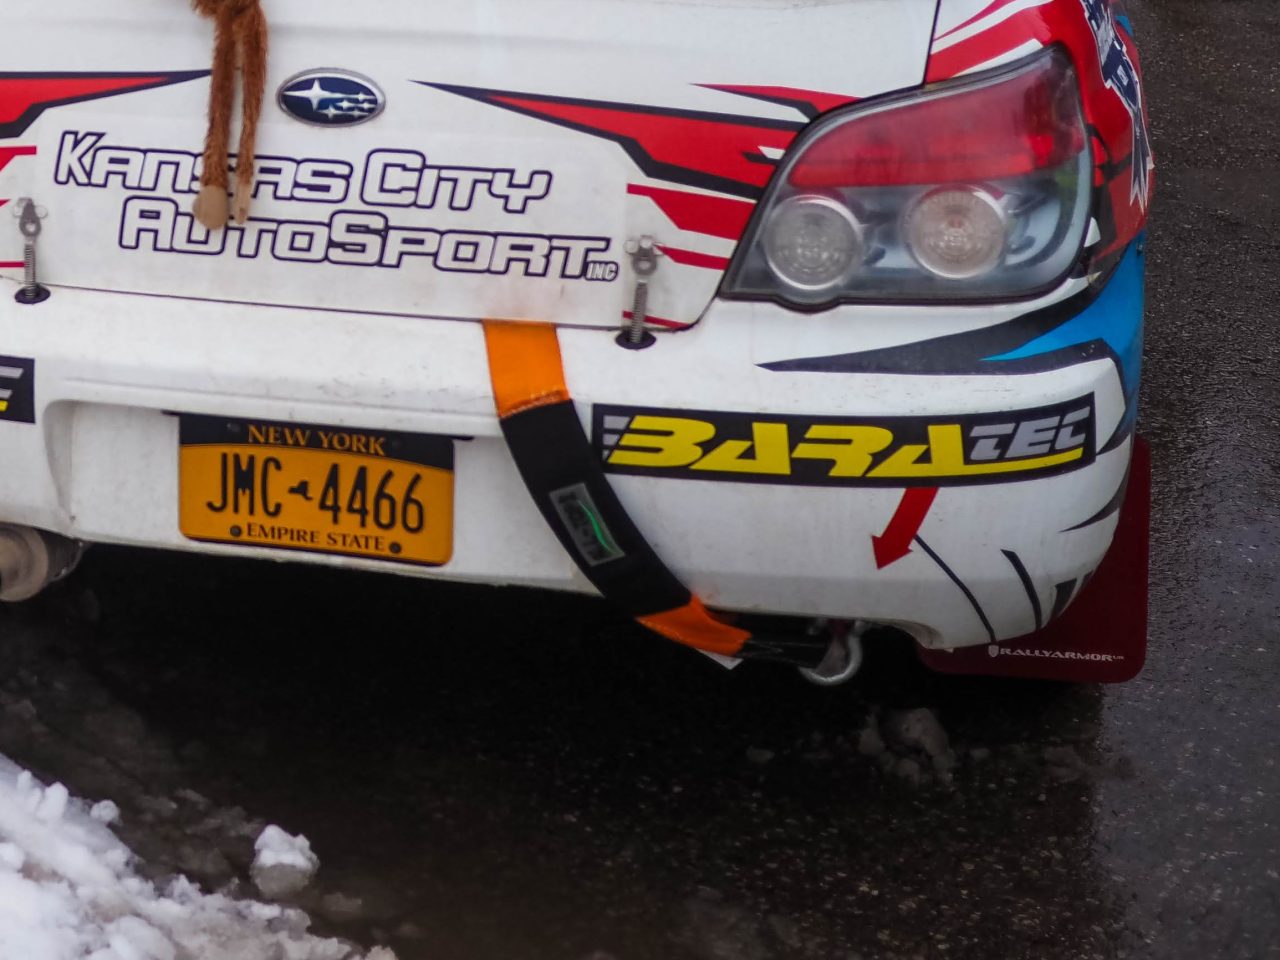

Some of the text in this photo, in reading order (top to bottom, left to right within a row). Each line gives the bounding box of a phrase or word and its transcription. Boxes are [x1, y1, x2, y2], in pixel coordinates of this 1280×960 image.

[247, 423, 386, 457] NEW YORK
[206, 452, 425, 534] JMC 4466
[247, 522, 386, 553] EMPIRE STATE
